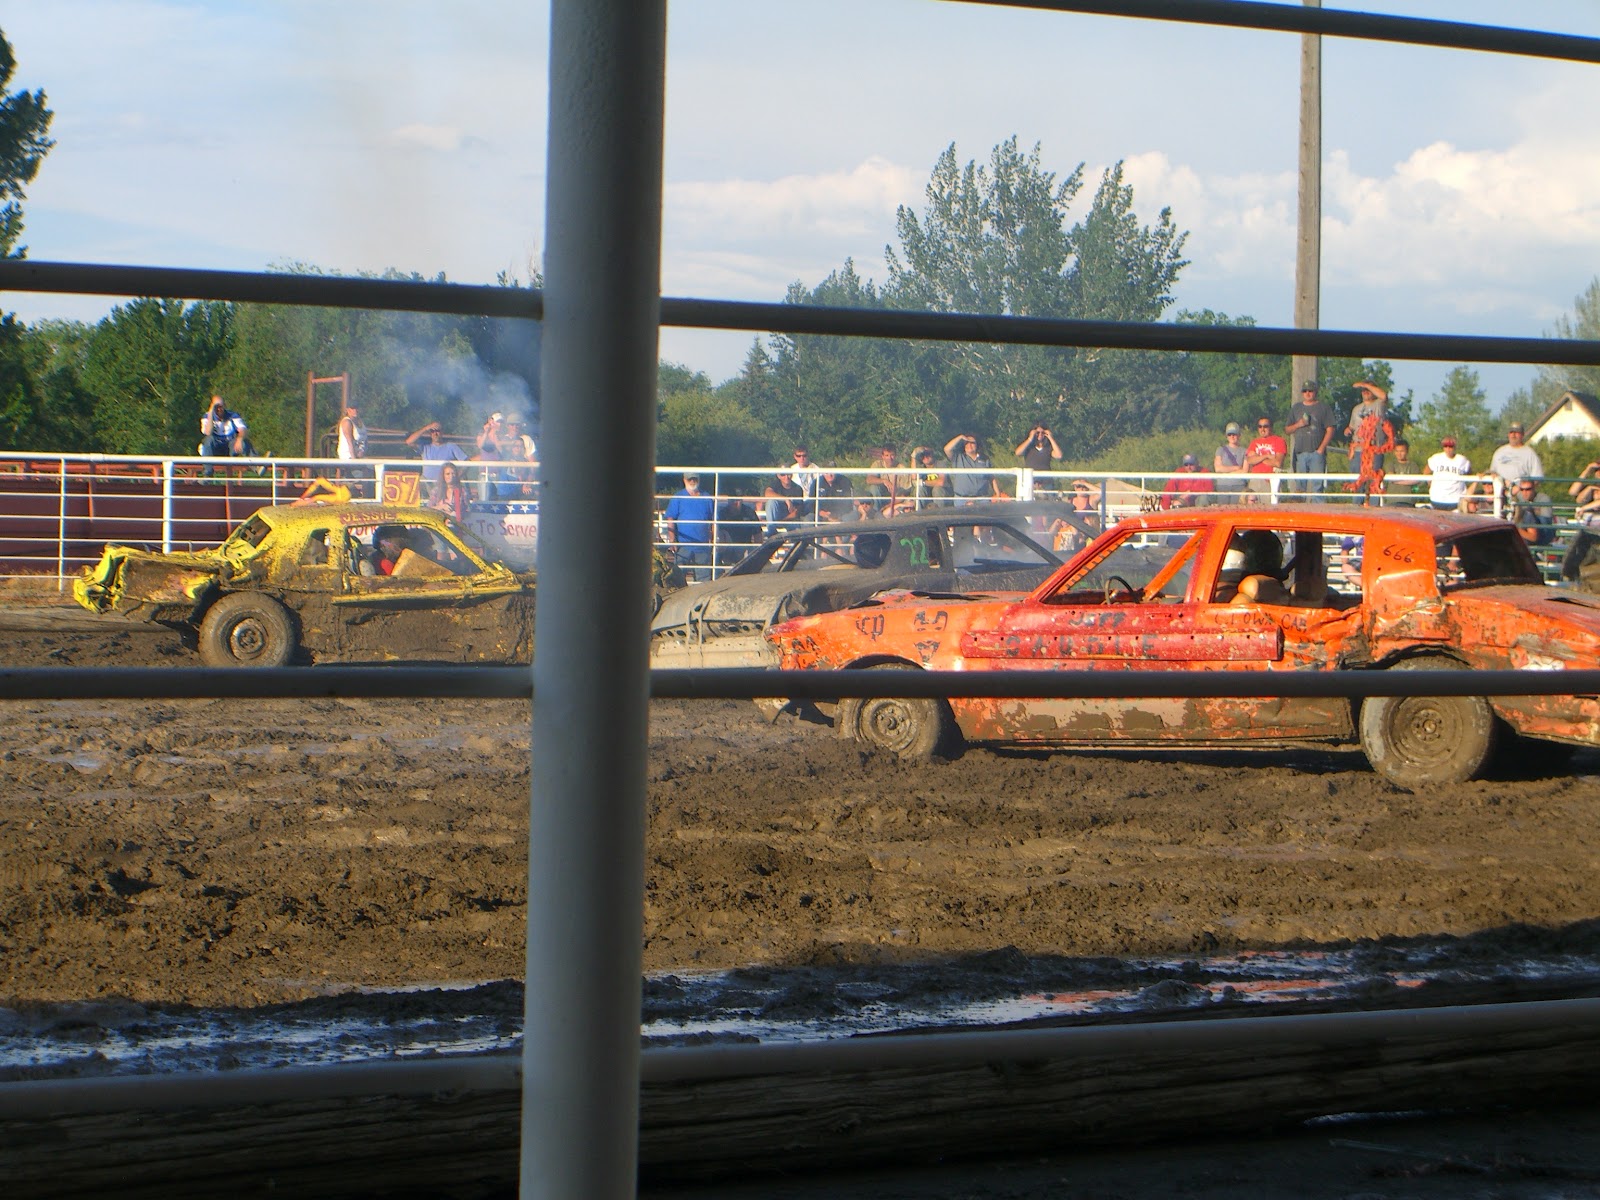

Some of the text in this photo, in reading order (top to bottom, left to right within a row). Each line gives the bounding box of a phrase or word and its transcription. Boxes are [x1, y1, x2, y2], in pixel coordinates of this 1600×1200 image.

[384, 474, 419, 503] 57
[476, 519, 496, 536] To
[498, 519, 537, 538] Serve
[900, 536, 930, 566] 22
[1383, 544, 1415, 563] 666
